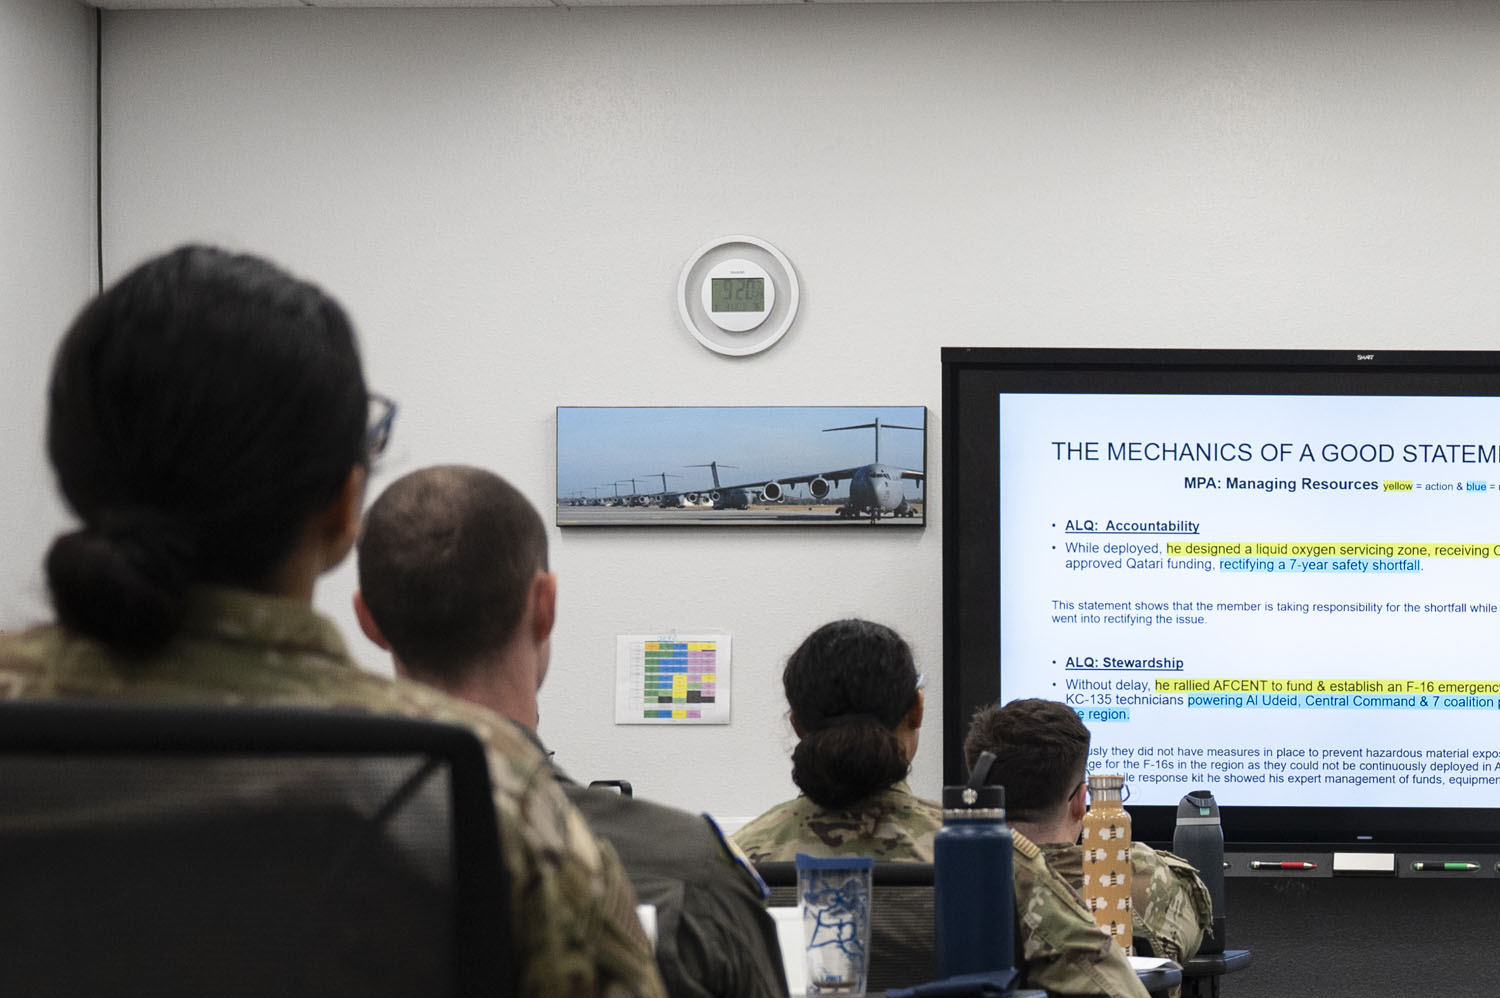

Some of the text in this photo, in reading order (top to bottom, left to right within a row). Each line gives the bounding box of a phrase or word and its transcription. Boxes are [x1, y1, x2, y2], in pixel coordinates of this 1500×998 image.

[1051, 442, 1099, 460] THE
[1108, 442, 1252, 462] MECHANICS
[1261, 443, 1293, 462] OF
[1299, 444, 1315, 463] A
[1322, 444, 1394, 462] GOOD
[1184, 477, 1221, 489] MPA:
[1226, 477, 1296, 492] Managing
[1302, 478, 1379, 490] Resources
[1383, 482, 1413, 492] yellow
[1425, 482, 1453, 490] action
[1466, 483, 1486, 492] blue
[1065, 519, 1200, 536] ALQ: Accountability
[1065, 543, 1099, 554] While
[1103, 544, 1162, 557] deployed,
[1185, 544, 1240, 557] designed
[1256, 544, 1287, 558] liquid
[1292, 546, 1335, 558] oxygen
[1340, 544, 1393, 558] servicing
[1397, 546, 1430, 557] zone,
[1435, 545, 1489, 558] receiving
[1066, 558, 1424, 573] approved Qatari funding, rectifying 7-year safety shortfall.
[1052, 601, 1074, 610] This
[1078, 601, 1131, 611] statement
[1135, 601, 1169, 611] shows
[1173, 602, 1193, 611] that
[1217, 602, 1261, 611] member
[1277, 602, 1309, 614] taking
[1313, 602, 1383, 615] responsibility
[1424, 603, 1466, 612] shortfall
[1470, 603, 1497, 612] while
[1052, 614, 1208, 626] went into rectifying issue.
[1065, 657, 1184, 671] ALQ: Stewardship
[1066, 679, 1112, 690] Without
[1116, 680, 1150, 694] delay,
[1174, 680, 1210, 691] rallied
[1213, 680, 1268, 691] AFCENT
[1287, 681, 1312, 692] fund
[1330, 681, 1383, 692] establish
[1407, 682, 1434, 693] F-16
[1066, 693, 1112, 705] KC-135
[1116, 694, 1184, 705] technicians
[1188, 694, 1243, 708] powering
[1262, 695, 1301, 708] Udeid,
[1305, 695, 1349, 706] Central
[1353, 695, 1416, 707] Command
[1444, 696, 1493, 707] coalition
[1089, 708, 1130, 722] region.
[1111, 747, 1134, 760] they
[1137, 747, 1153, 757] did
[1157, 747, 1174, 757] not
[1178, 747, 1203, 757] have
[1207, 749, 1260, 757] measures
[1276, 748, 1305, 761] place
[1322, 748, 1363, 761] prevent
[1366, 748, 1422, 758] hazardous
[1426, 748, 1469, 758] material
[1143, 760, 1174, 769] F-16s
[1211, 760, 1244, 773] region
[1264, 761, 1287, 773] they
[1290, 761, 1319, 770] could
[1322, 761, 1339, 770] not
[1359, 761, 1427, 773] continuously
[1430, 762, 1479, 774] deployed
[1138, 775, 1188, 785] response
[1192, 773, 1204, 783] kit
[1224, 773, 1265, 783] showed
[1269, 774, 1284, 783] his
[1288, 774, 1321, 786] expert
[1325, 774, 1396, 786] management
[1412, 774, 1445, 786] funds,
